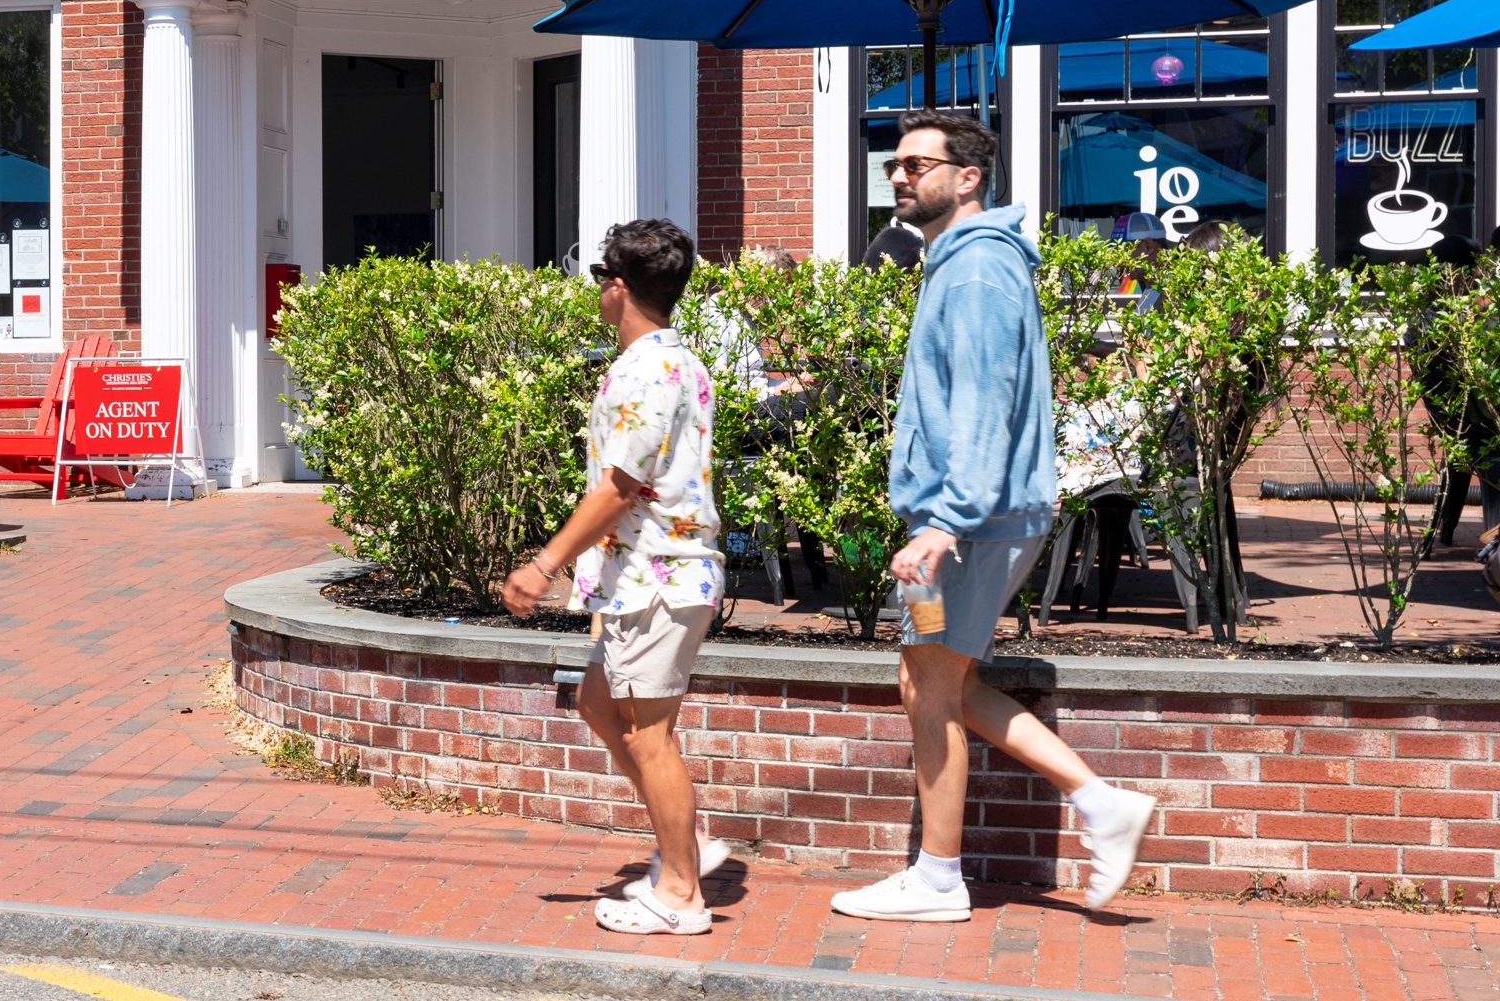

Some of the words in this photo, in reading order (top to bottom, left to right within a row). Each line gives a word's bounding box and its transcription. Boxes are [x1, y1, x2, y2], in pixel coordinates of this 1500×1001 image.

[1347, 102, 1464, 163] BUZZ
[102, 373, 152, 382] CHRISTIE'S
[95, 401, 160, 418] AGENT
[85, 422, 113, 439] ON
[117, 421, 171, 438] DUTY
